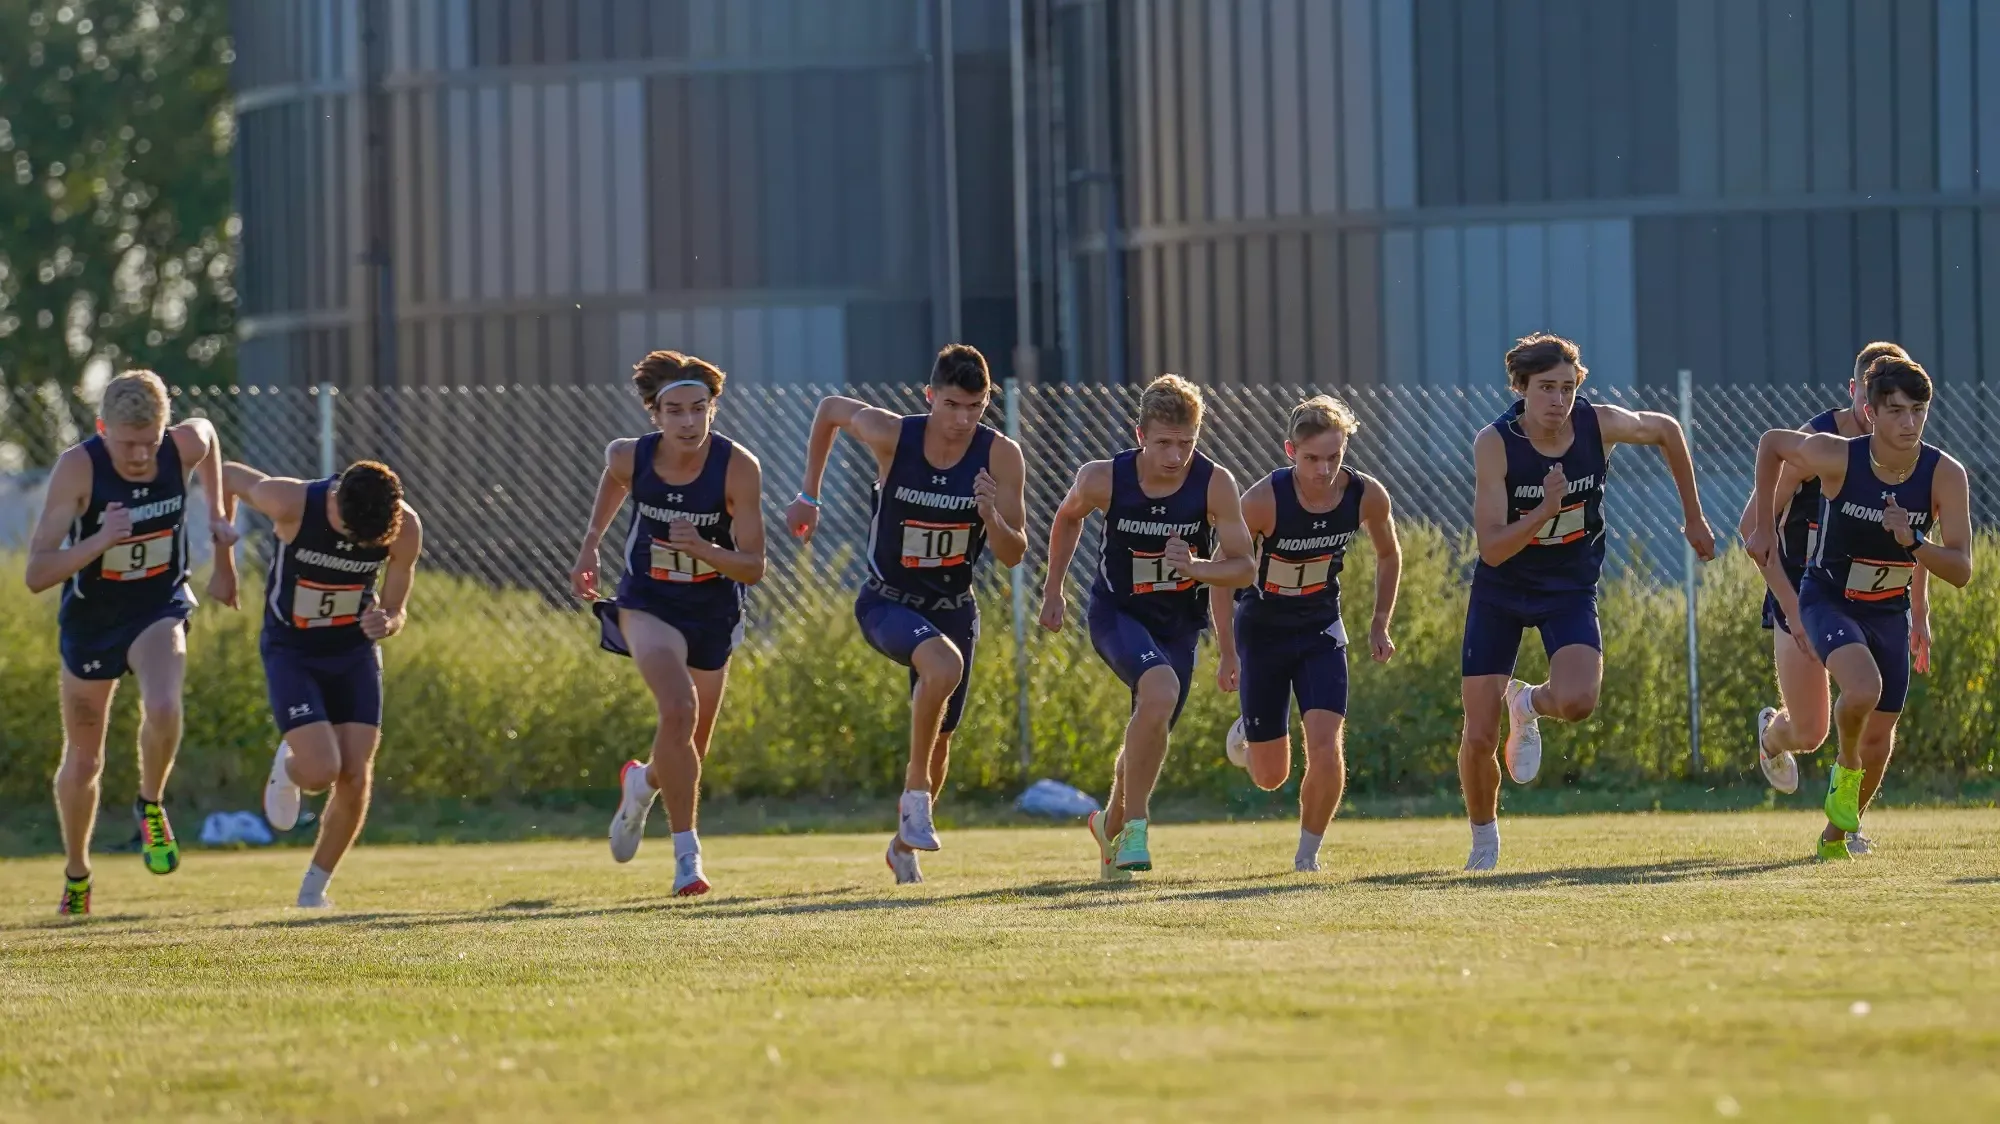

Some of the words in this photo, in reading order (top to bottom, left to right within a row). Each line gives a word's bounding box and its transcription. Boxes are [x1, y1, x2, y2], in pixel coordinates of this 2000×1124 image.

[895, 486, 977, 510] MONMOUTH
[1514, 475, 1594, 498] MONUTH
[97, 495, 183, 525] MOUTH
[1841, 501, 1928, 525] MONTH
[922, 530, 953, 558] 10
[1276, 530, 1355, 552] MONMOUTH
[130, 541, 146, 570] 9
[1295, 563, 1306, 588] 1
[1871, 566, 1890, 592] 2
[319, 592, 337, 619] 5
